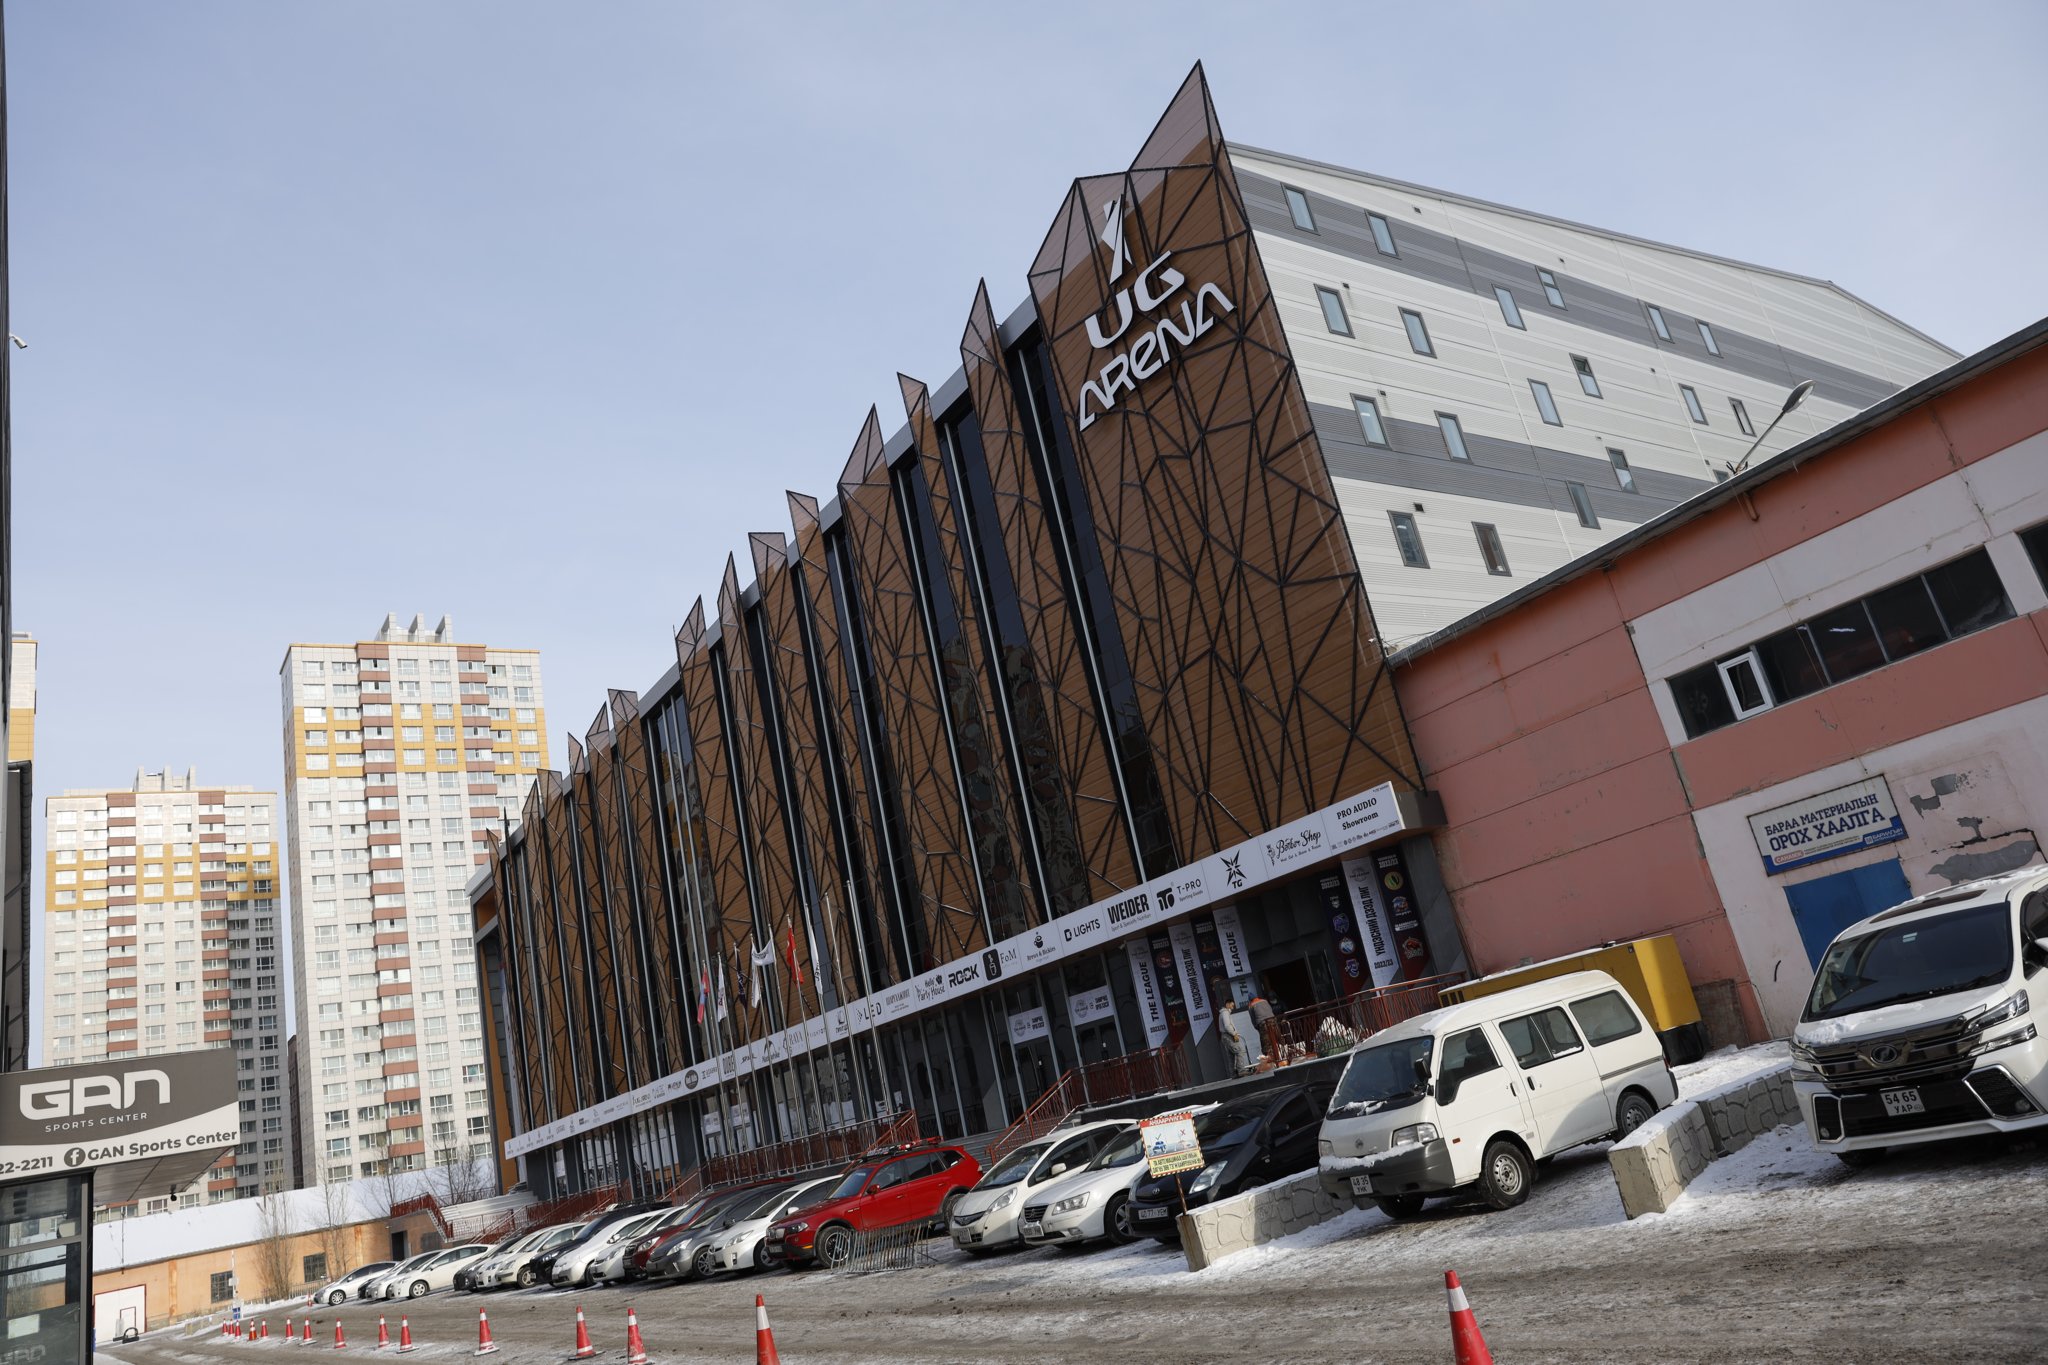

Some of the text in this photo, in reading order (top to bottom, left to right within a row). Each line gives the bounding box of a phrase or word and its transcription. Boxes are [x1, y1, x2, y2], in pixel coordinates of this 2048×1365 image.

[1085, 250, 1185, 349] UG
[1336, 797, 1377, 820] PRO AUDIO
[1342, 812, 1379, 830] Showroom
[1764, 793, 1879, 836] БАРАА МАТЕРИАЛЫН
[1769, 828, 1813, 851] ОРОХ
[1813, 807, 1885, 840] ХААЛГА
[1176, 878, 1201, 894] T-PRO
[1232, 879, 1243, 889] TG
[1107, 893, 1150, 924] WEIDER
[1073, 918, 1100, 937] LIGHTS
[1226, 931, 1243, 973] LEAGUE
[948, 963, 980, 988] ROCK
[1139, 961, 1154, 1000] LEAGUE
[1148, 1001, 1159, 1022] THE
[20, 1069, 171, 1120] GAN
[45, 1112, 148, 1133] SPORTS CENTER
[88, 1145, 124, 1161] GAN
[129, 1138, 181, 1156] Sports
[186, 1130, 238, 1147] Center
